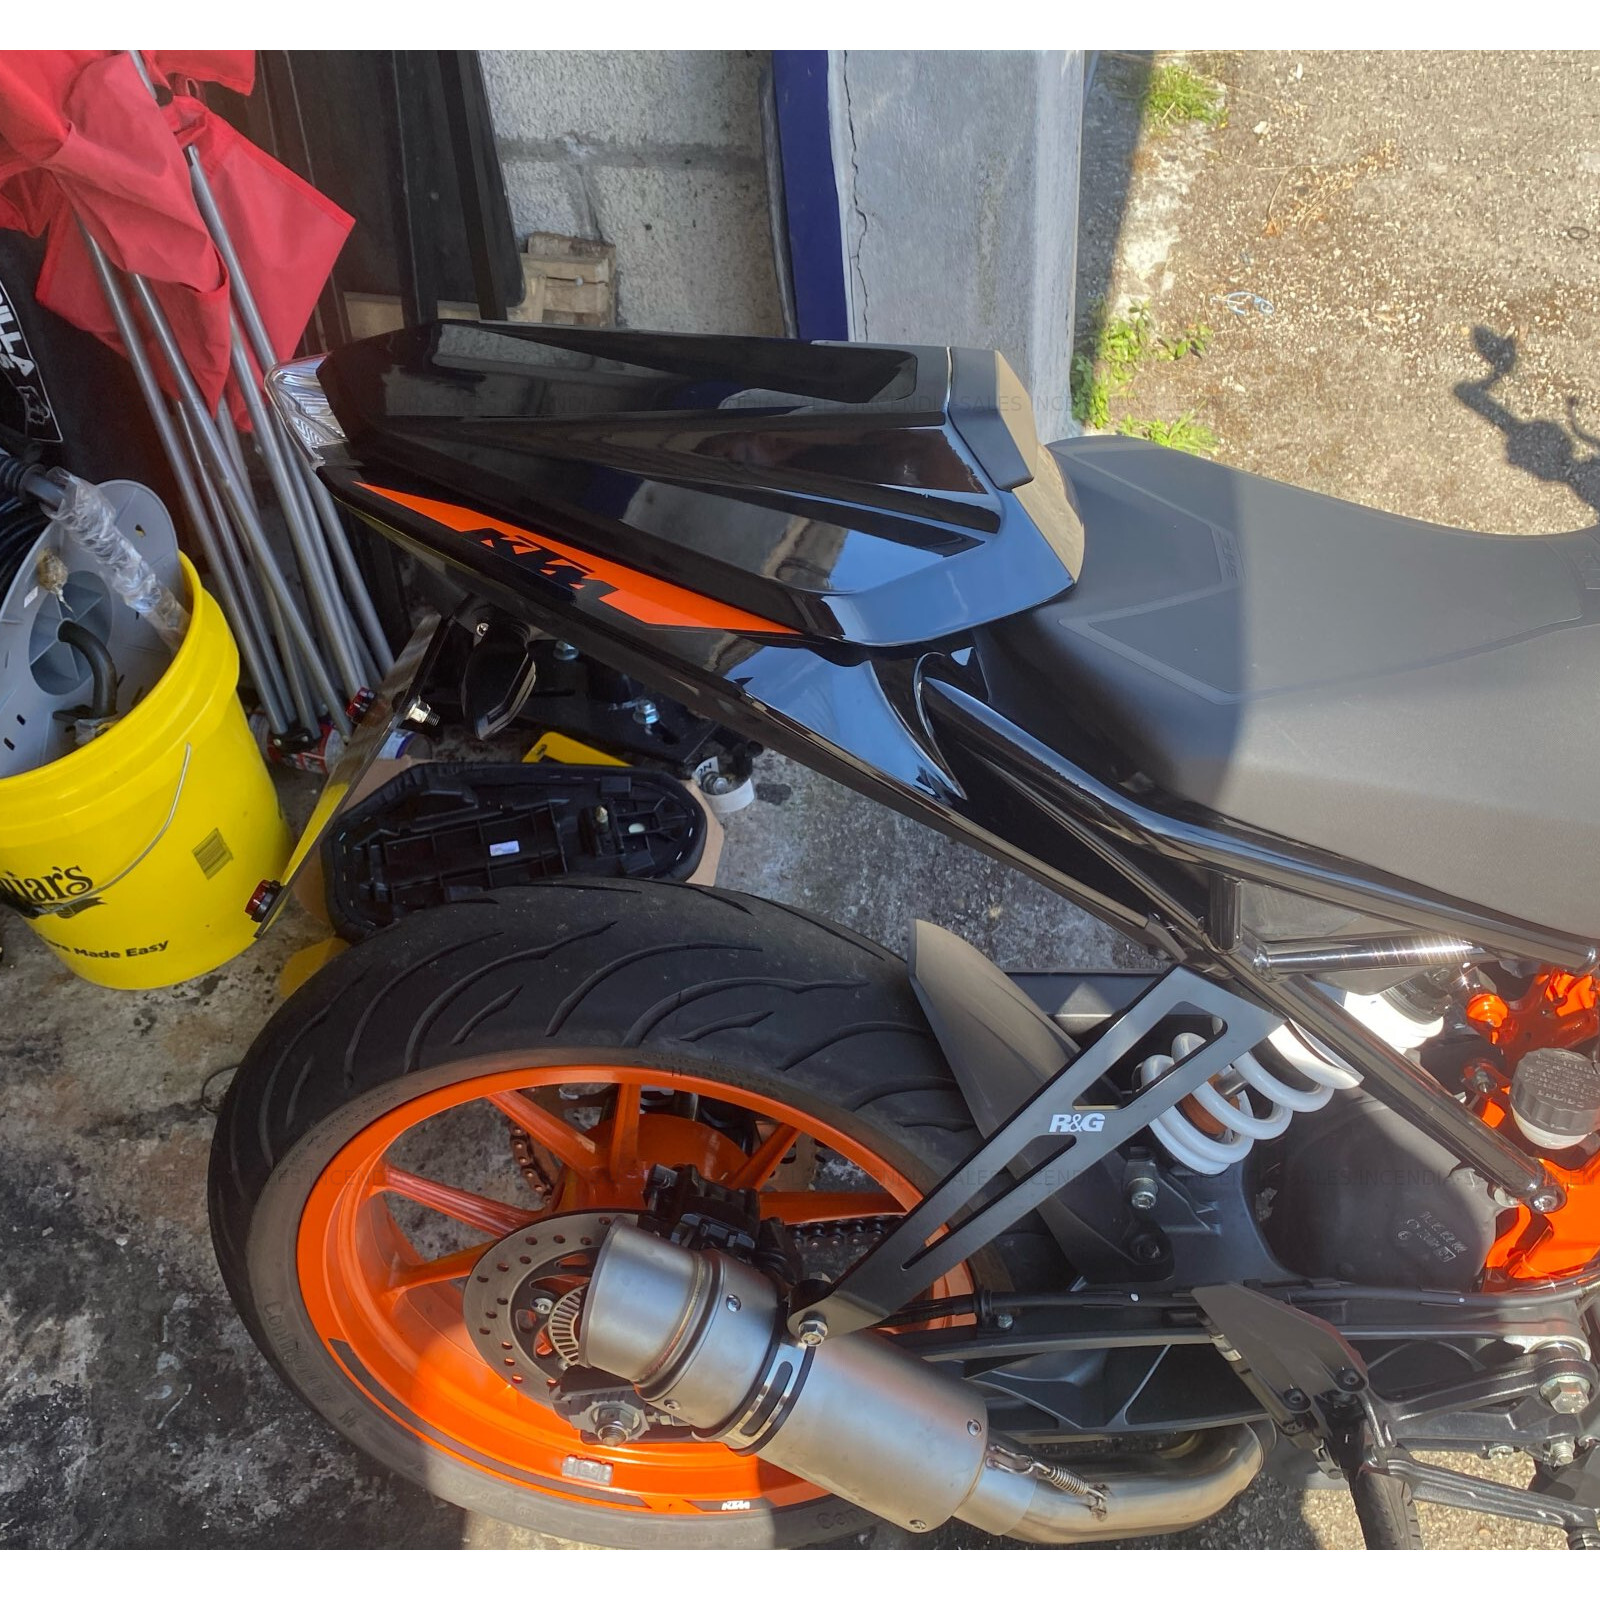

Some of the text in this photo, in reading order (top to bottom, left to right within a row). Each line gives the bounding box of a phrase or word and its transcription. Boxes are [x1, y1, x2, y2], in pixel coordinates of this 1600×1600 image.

[457, 527, 619, 602] KTM
[73, 940, 169, 958] Made Easy
[1049, 1112, 1105, 1132] R&G
[721, 1501, 751, 1511] KTM
